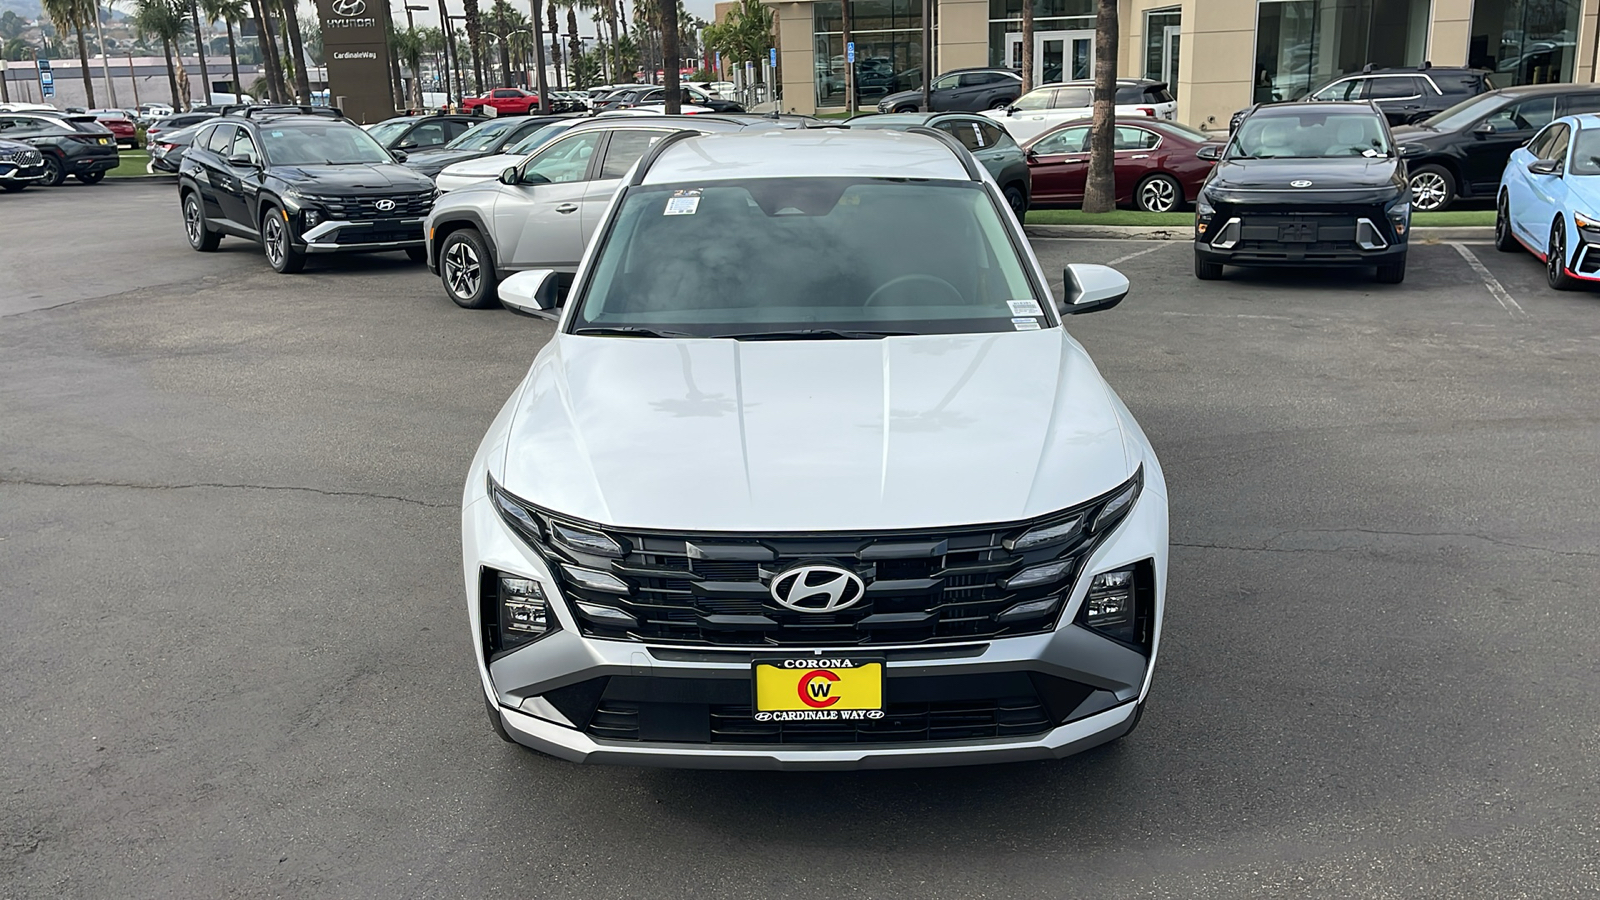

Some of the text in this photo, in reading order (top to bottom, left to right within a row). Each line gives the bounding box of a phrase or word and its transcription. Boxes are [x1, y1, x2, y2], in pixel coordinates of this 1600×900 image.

[326, 18, 375, 28] HYUNDAI
[784, 659, 853, 668] CORONA
[773, 710, 866, 721] CARDINALE WAY
